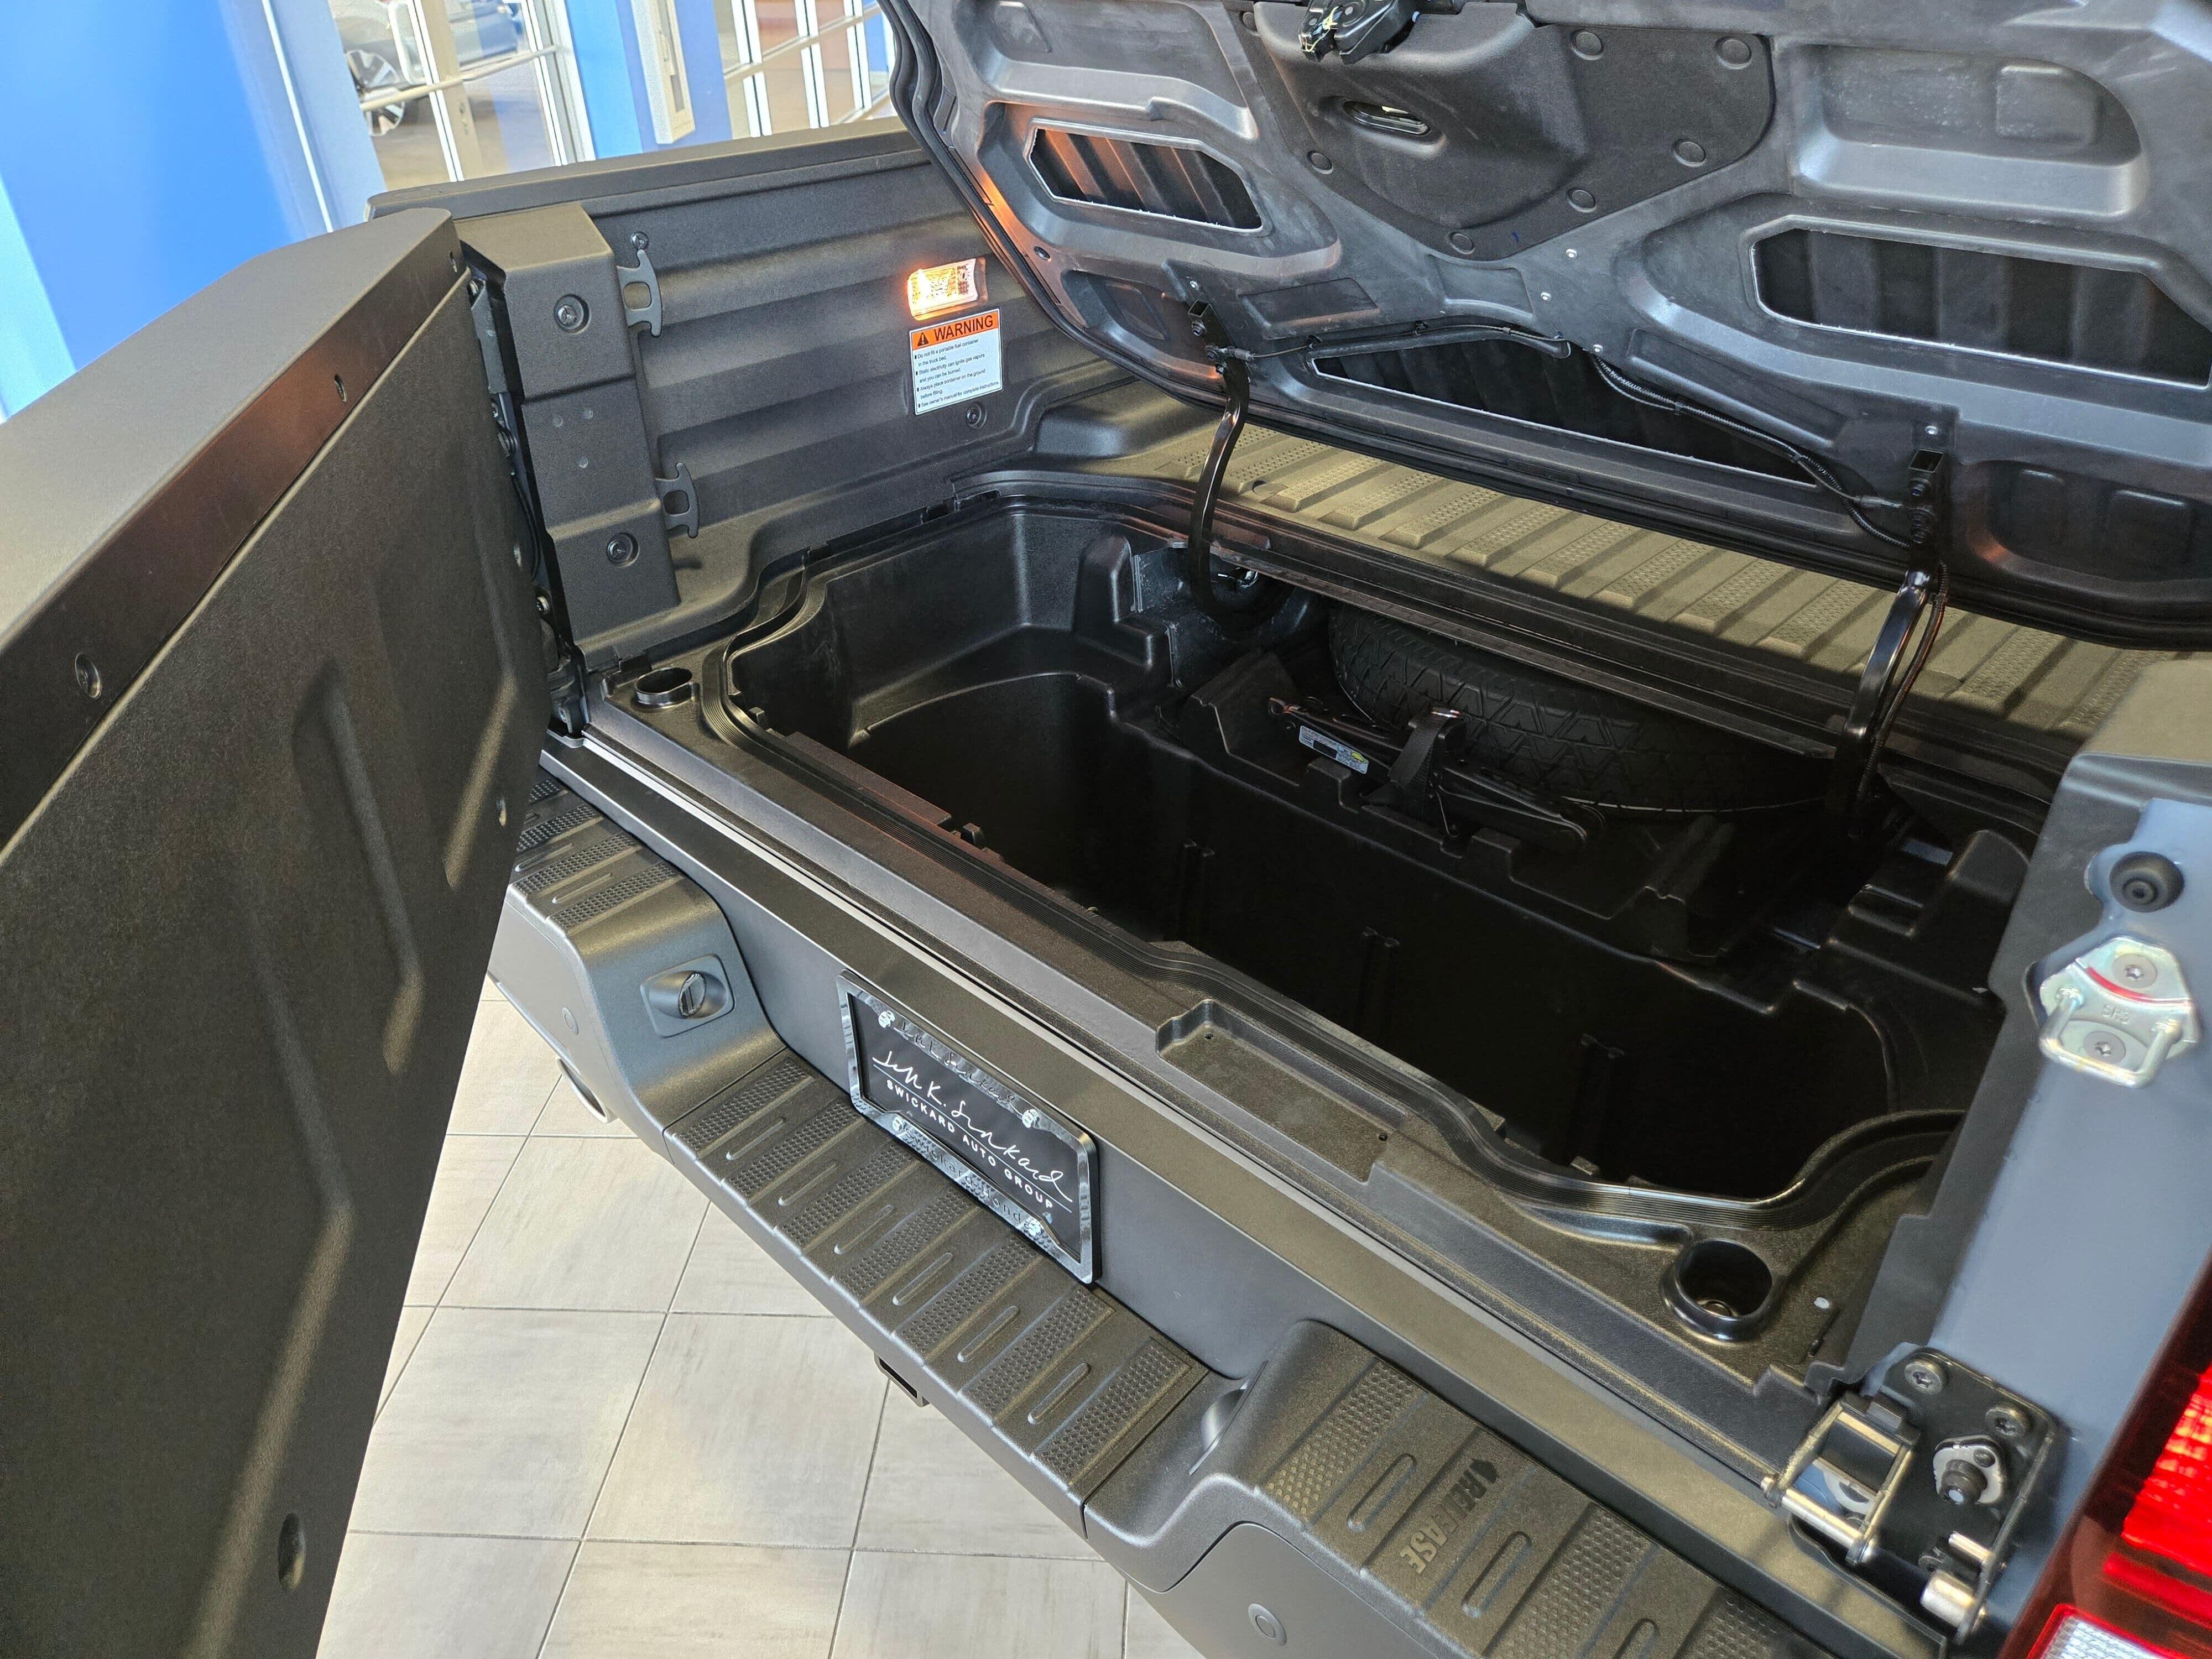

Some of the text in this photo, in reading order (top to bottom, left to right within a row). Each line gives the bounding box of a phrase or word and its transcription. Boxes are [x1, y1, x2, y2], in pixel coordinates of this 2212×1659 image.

[934, 315, 993, 342] WARNING
[962, 338, 979, 347] container
[930, 364, 947, 372] electricity
[944, 375, 961, 384] container
[973, 368, 985, 377] ground
[963, 387, 979, 395] complete
[886, 1079, 1053, 1208] SWICKARD AUTO GROUP
[1399, 1470, 1488, 1575] RELEASE
